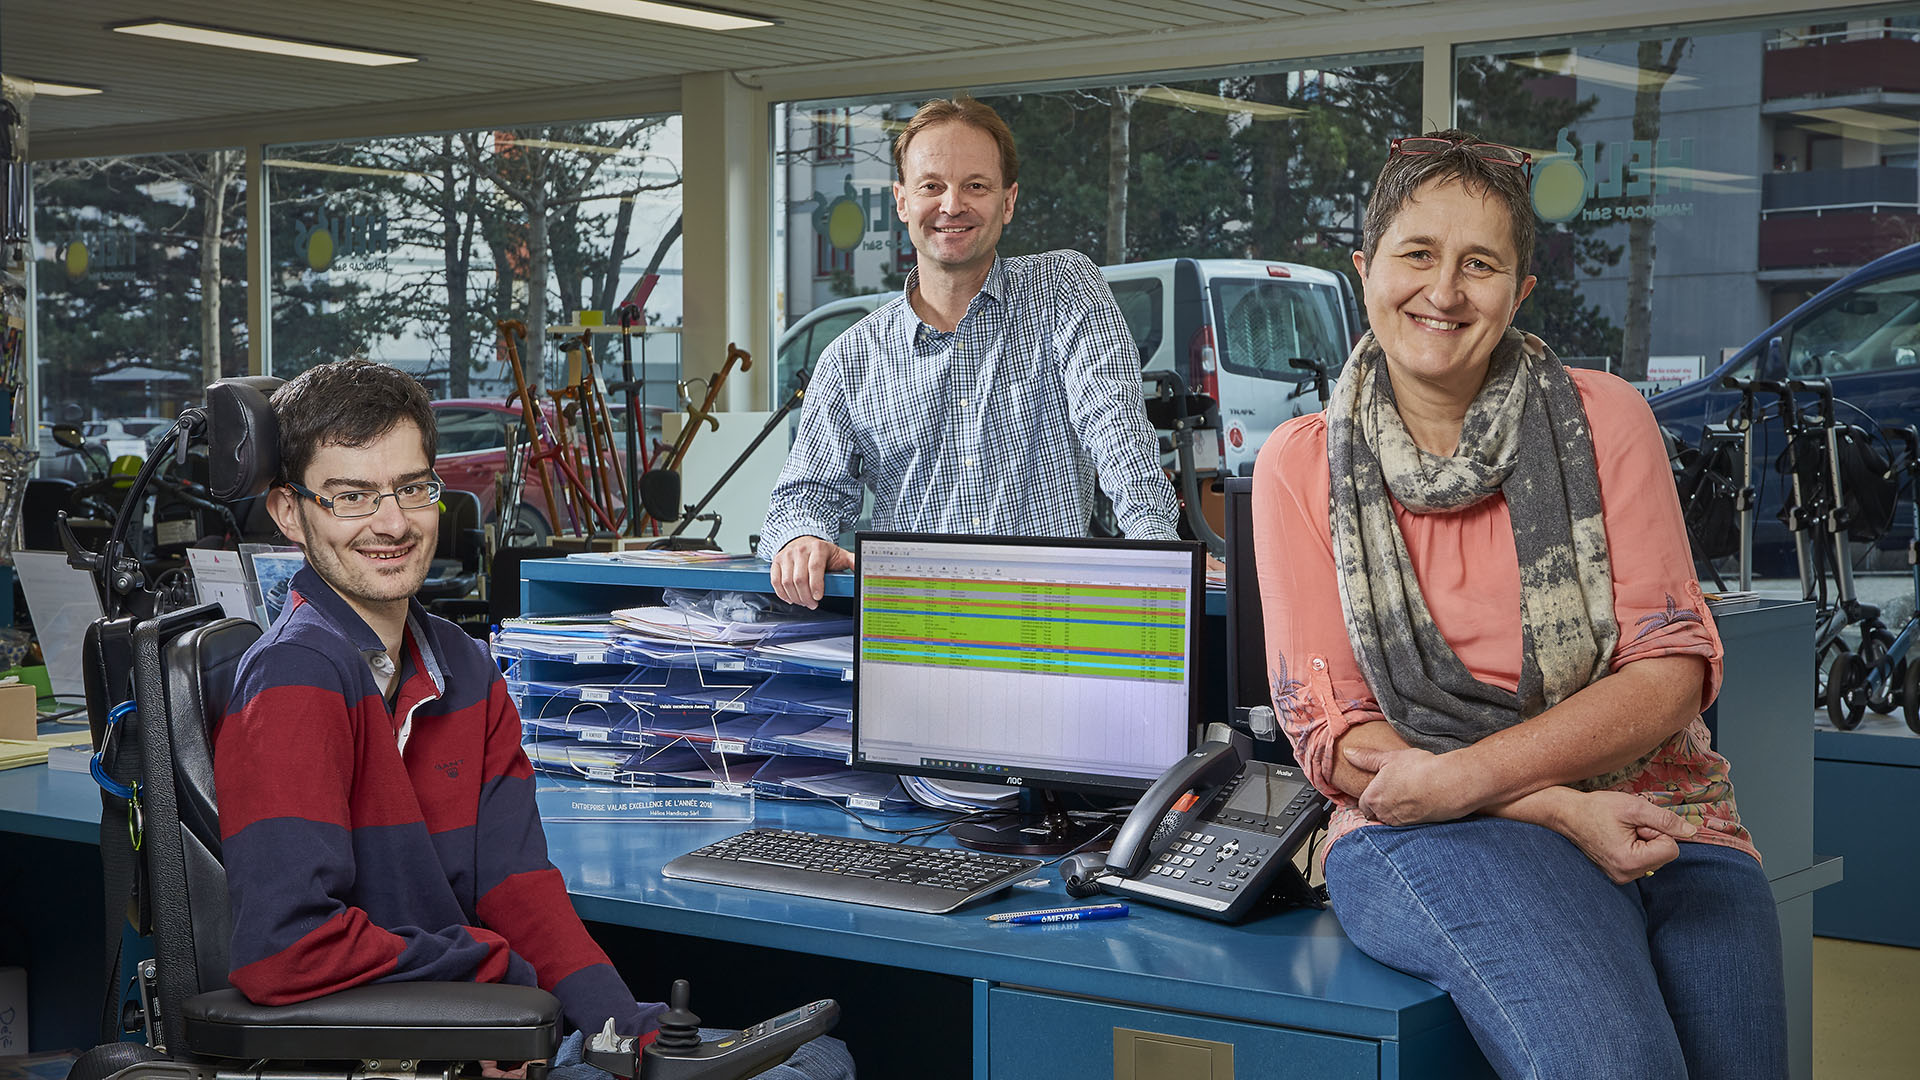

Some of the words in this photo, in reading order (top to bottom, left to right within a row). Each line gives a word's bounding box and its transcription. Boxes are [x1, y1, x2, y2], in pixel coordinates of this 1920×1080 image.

[1006, 776, 1022, 785] AOC
[572, 801, 606, 811] ENTREPRISE
[607, 803, 627, 811] VALAIS
[629, 800, 663, 810] EXCELLENCE
[665, 799, 672, 807] DE
[674, 798, 698, 807] L'ANNÉE
[699, 800, 713, 808] 2018
[1046, 913, 1080, 922] MEYRA
